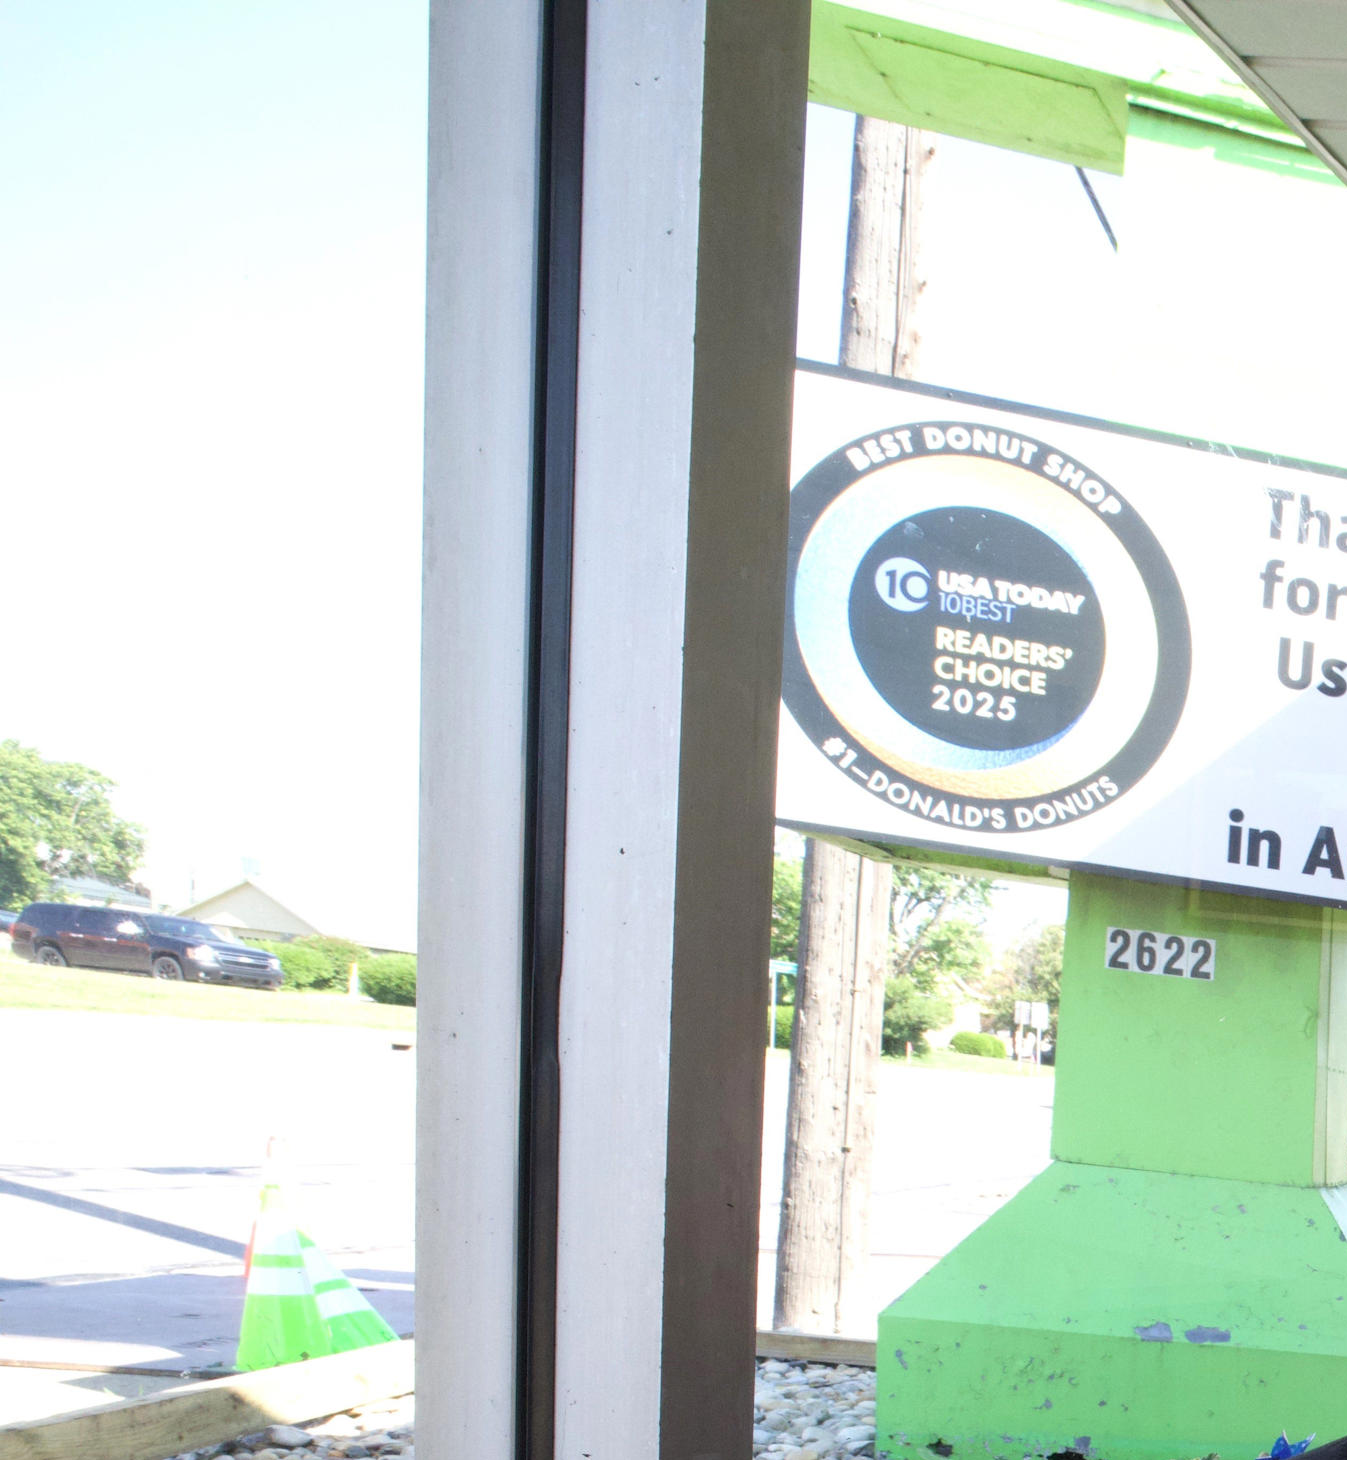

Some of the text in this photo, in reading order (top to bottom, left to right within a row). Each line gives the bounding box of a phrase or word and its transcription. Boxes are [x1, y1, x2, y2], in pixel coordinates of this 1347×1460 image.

[845, 425, 1124, 516] BEST DONUT SHOP
[937, 570, 1086, 615] USA TODAY
[938, 591, 1017, 623] 10BEST
[935, 625, 1074, 670] READERS'
[934, 655, 1047, 696] CHOICE
[931, 684, 1018, 721] 2025
[1014, 775, 1119, 829] DONUTS
[1226, 807, 1282, 870] in
[1107, 928, 1213, 980] 2622
